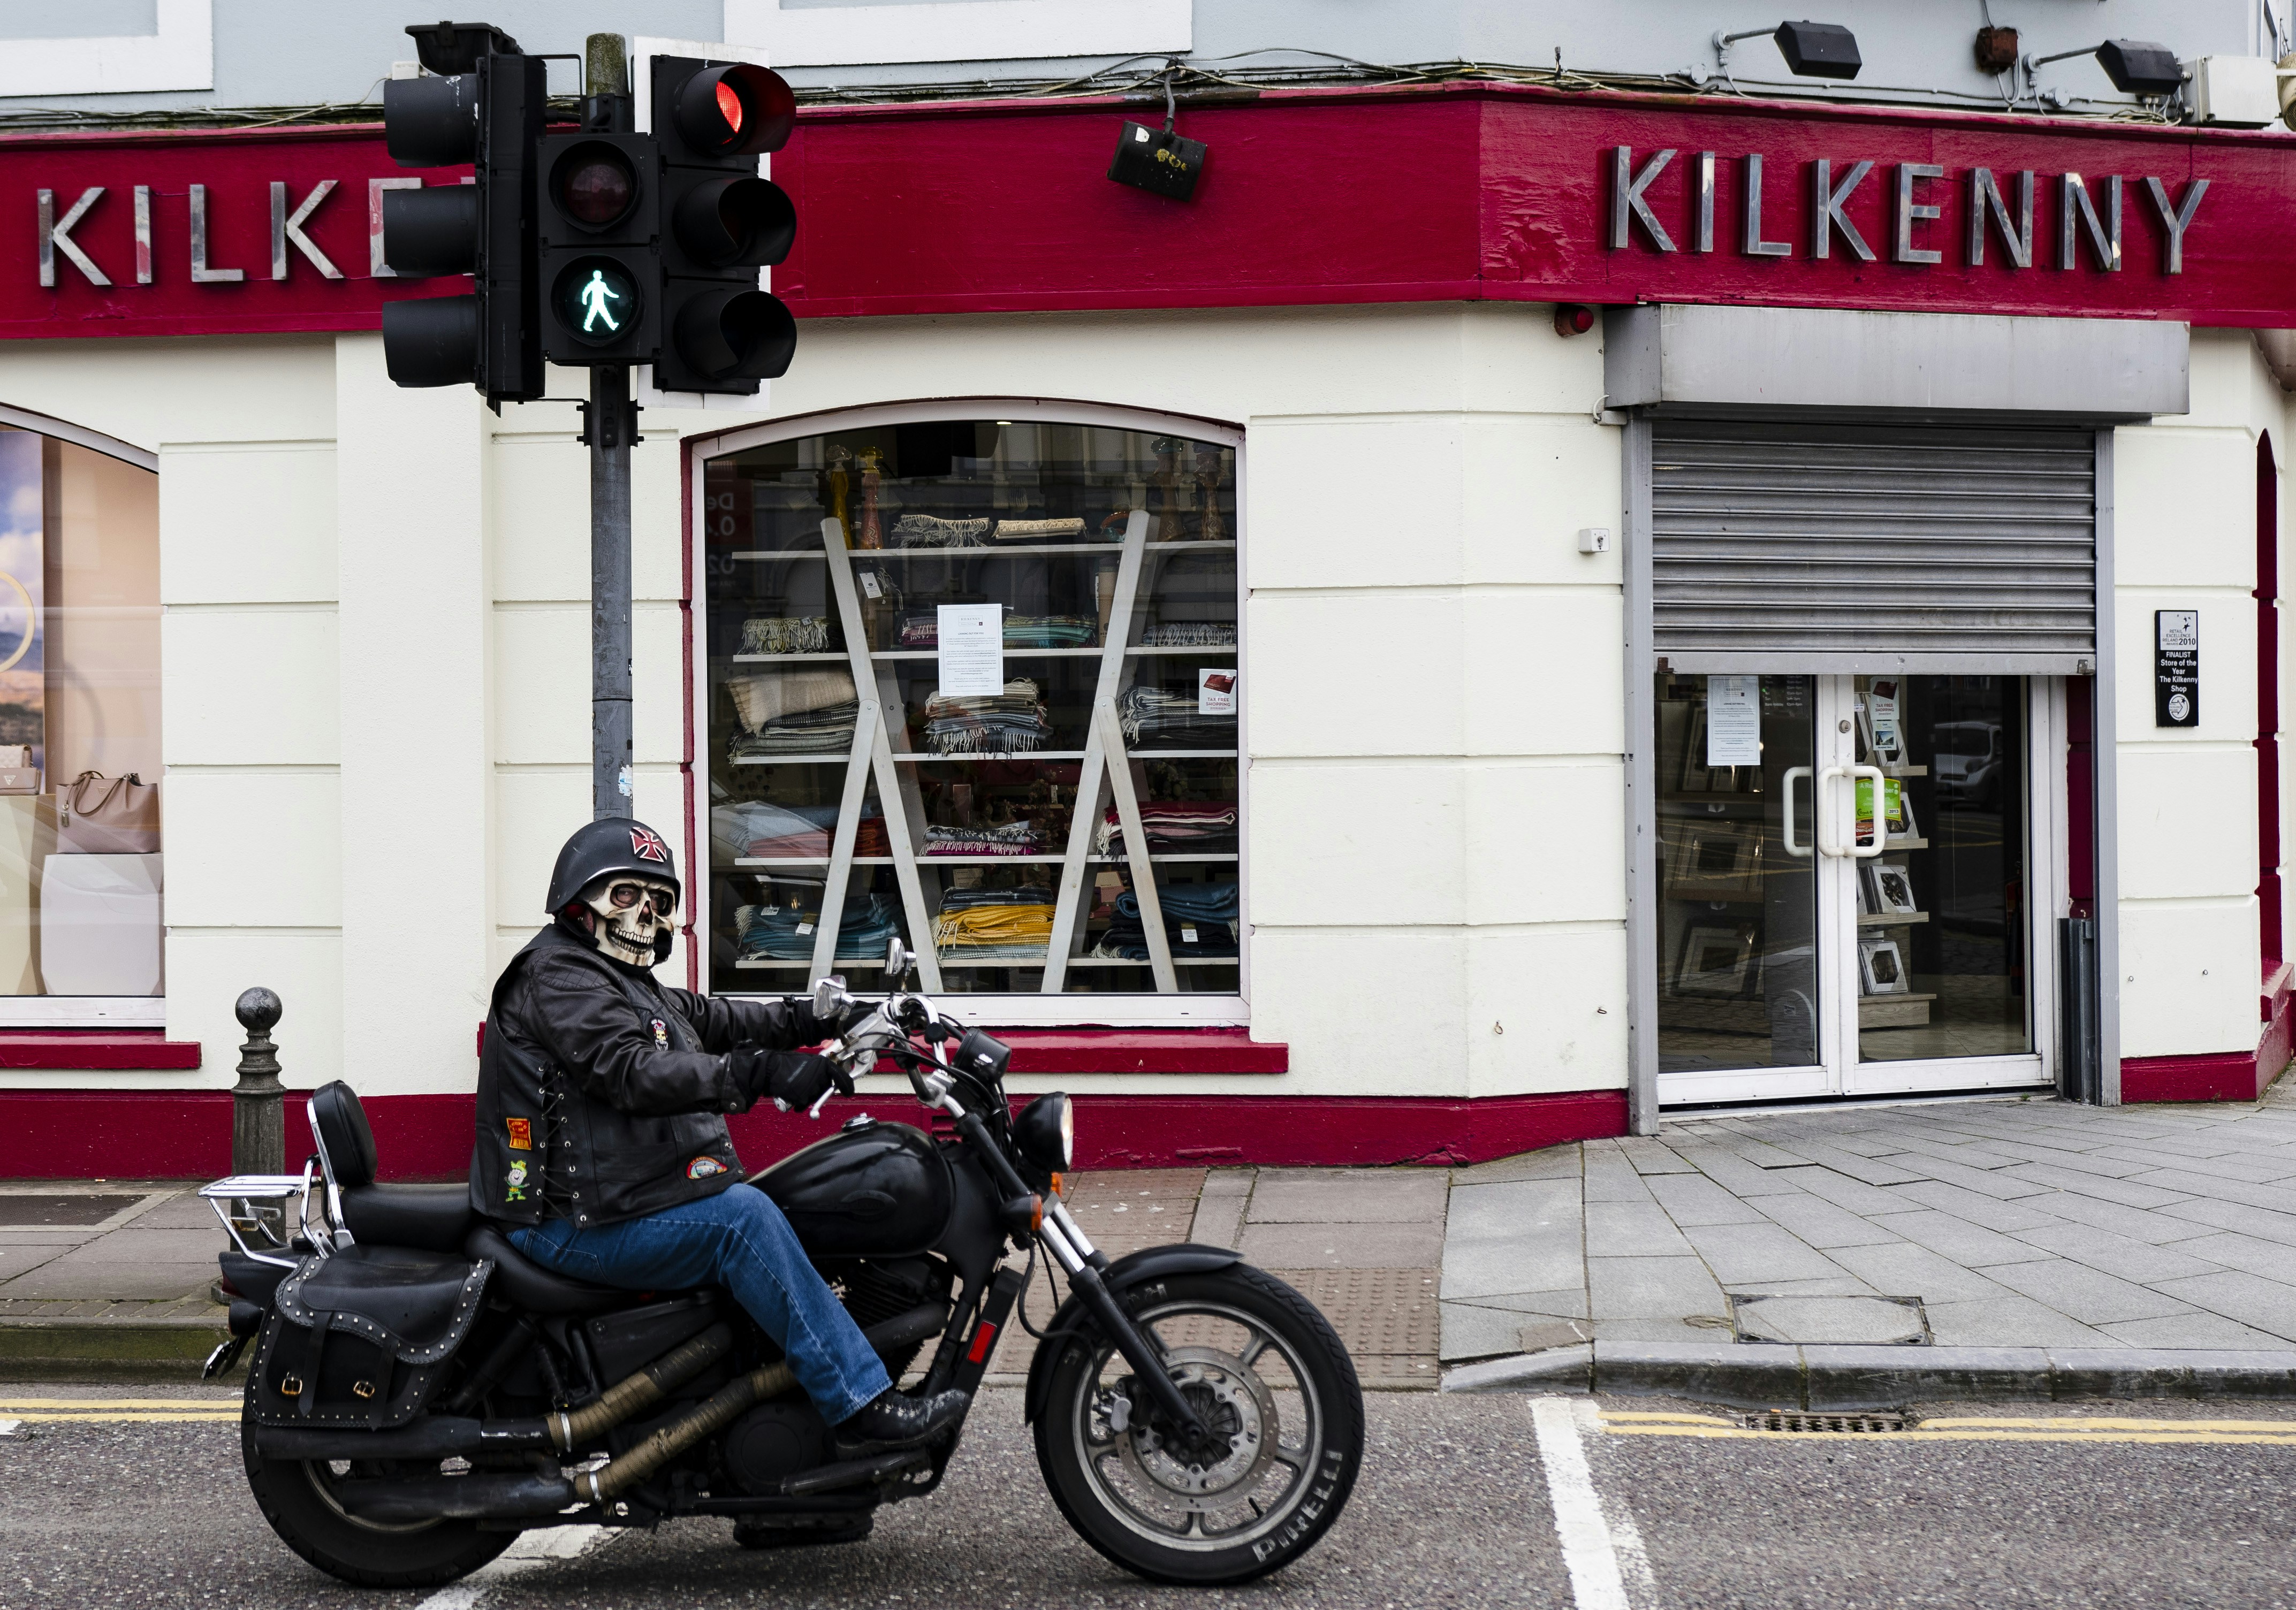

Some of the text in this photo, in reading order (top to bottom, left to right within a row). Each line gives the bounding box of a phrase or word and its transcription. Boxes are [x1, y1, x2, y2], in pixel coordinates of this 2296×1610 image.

[1608, 145, 2211, 275] KILKENNY
[2170, 685, 2187, 693] Shop
[2172, 675, 2198, 684] Kilkenny
[1251, 1449, 1343, 1562] PIRELLI
